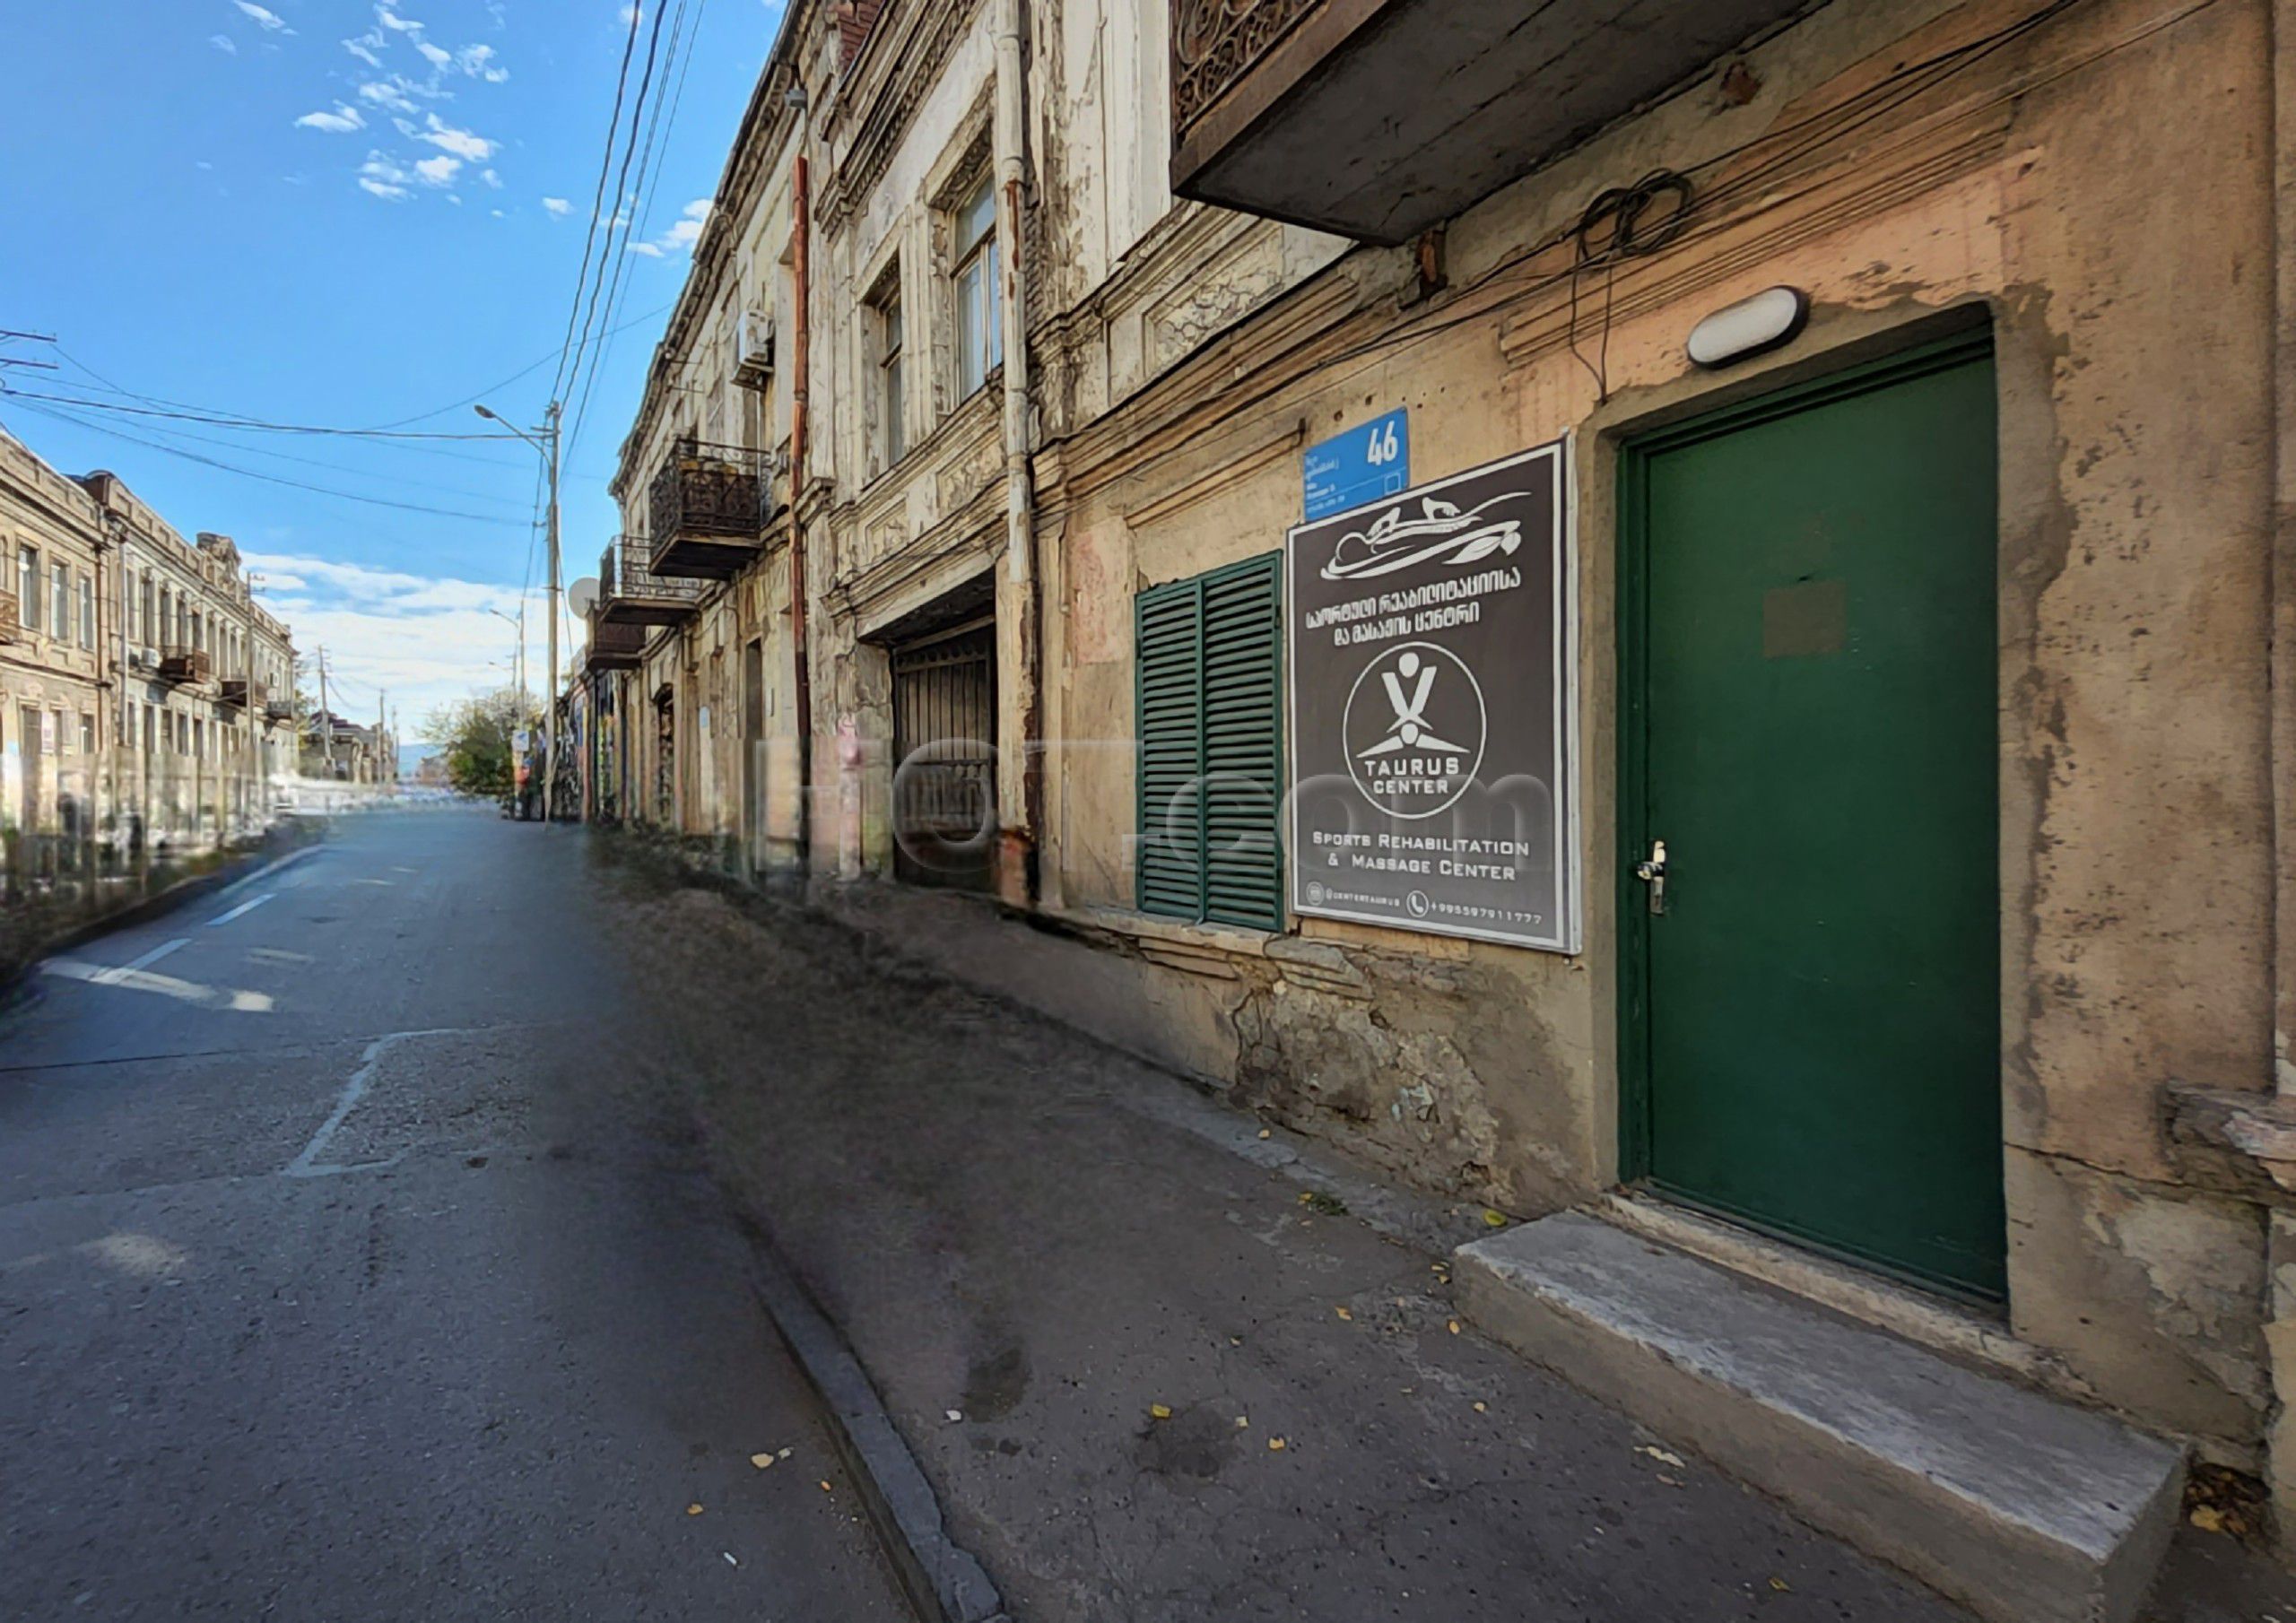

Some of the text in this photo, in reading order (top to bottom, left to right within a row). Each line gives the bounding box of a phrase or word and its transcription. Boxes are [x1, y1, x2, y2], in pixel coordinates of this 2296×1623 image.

[1366, 420, 1399, 466] 46
[1334, 628, 1351, 647] და
[1364, 757, 1460, 777] TAURUS
[1373, 778, 1449, 794] CENTER
[1327, 852, 1339, 867] &
